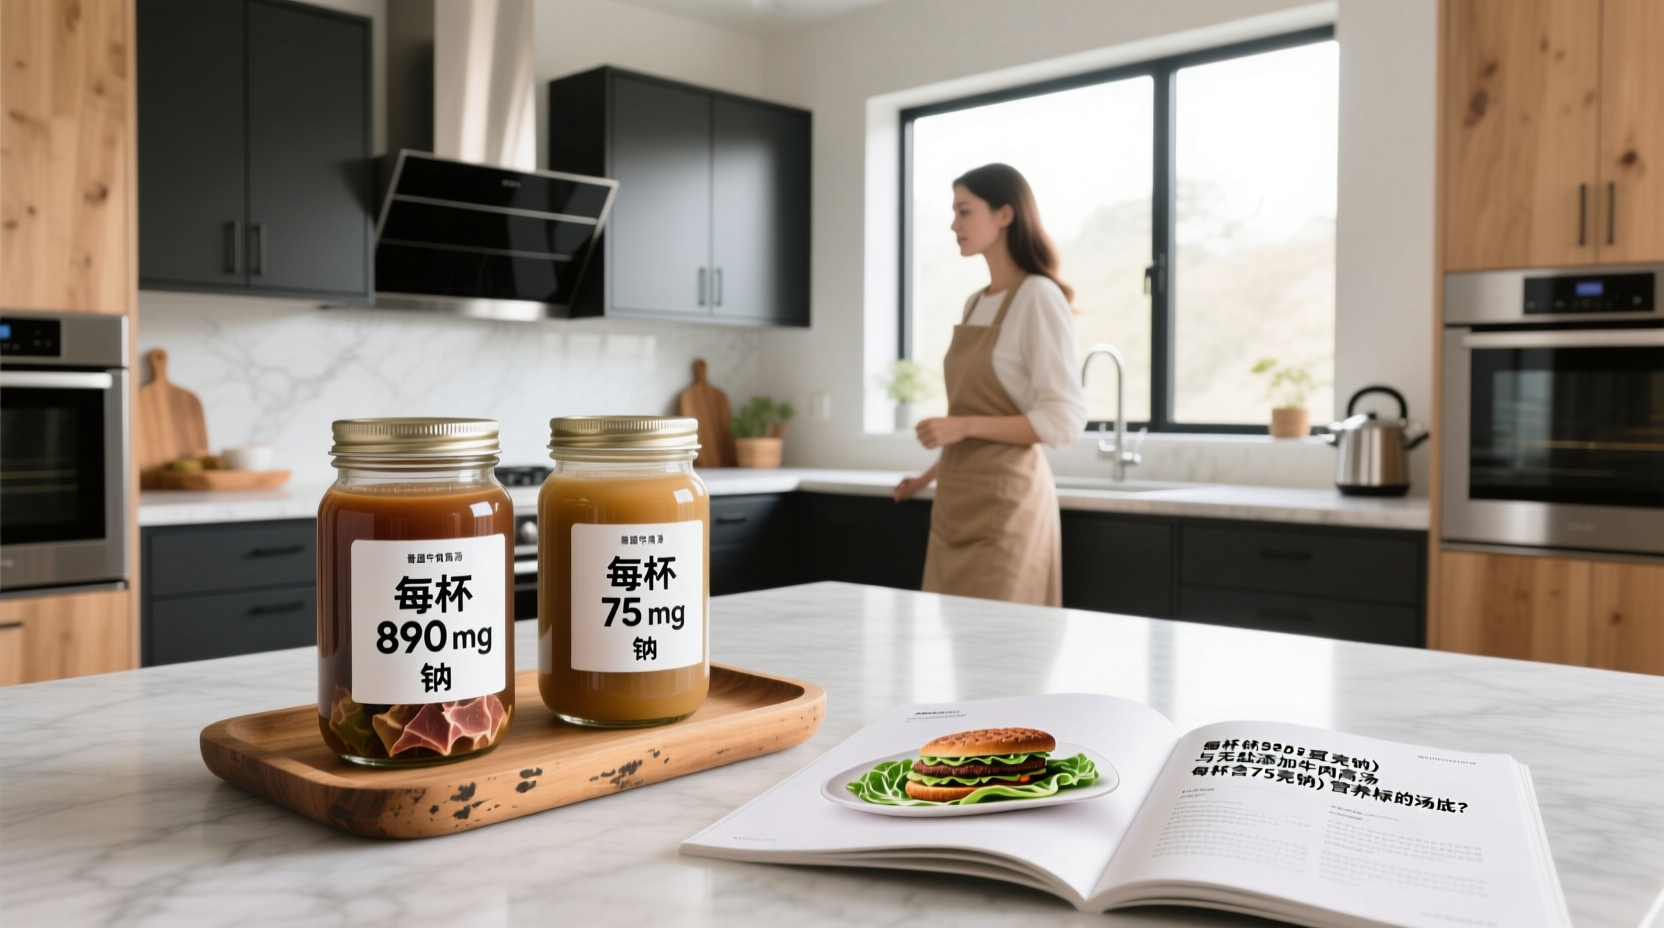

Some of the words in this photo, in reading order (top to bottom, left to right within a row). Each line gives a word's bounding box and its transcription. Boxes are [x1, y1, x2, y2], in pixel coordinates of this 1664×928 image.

[606, 555, 677, 592] 每杯
[394, 574, 473, 615] 每杯
[601, 597, 642, 628] 75
[648, 604, 685, 631] mg
[376, 619, 448, 655] 890
[453, 626, 492, 655] mg
[632, 635, 657, 662] 钠
[420, 662, 452, 694] 钠
